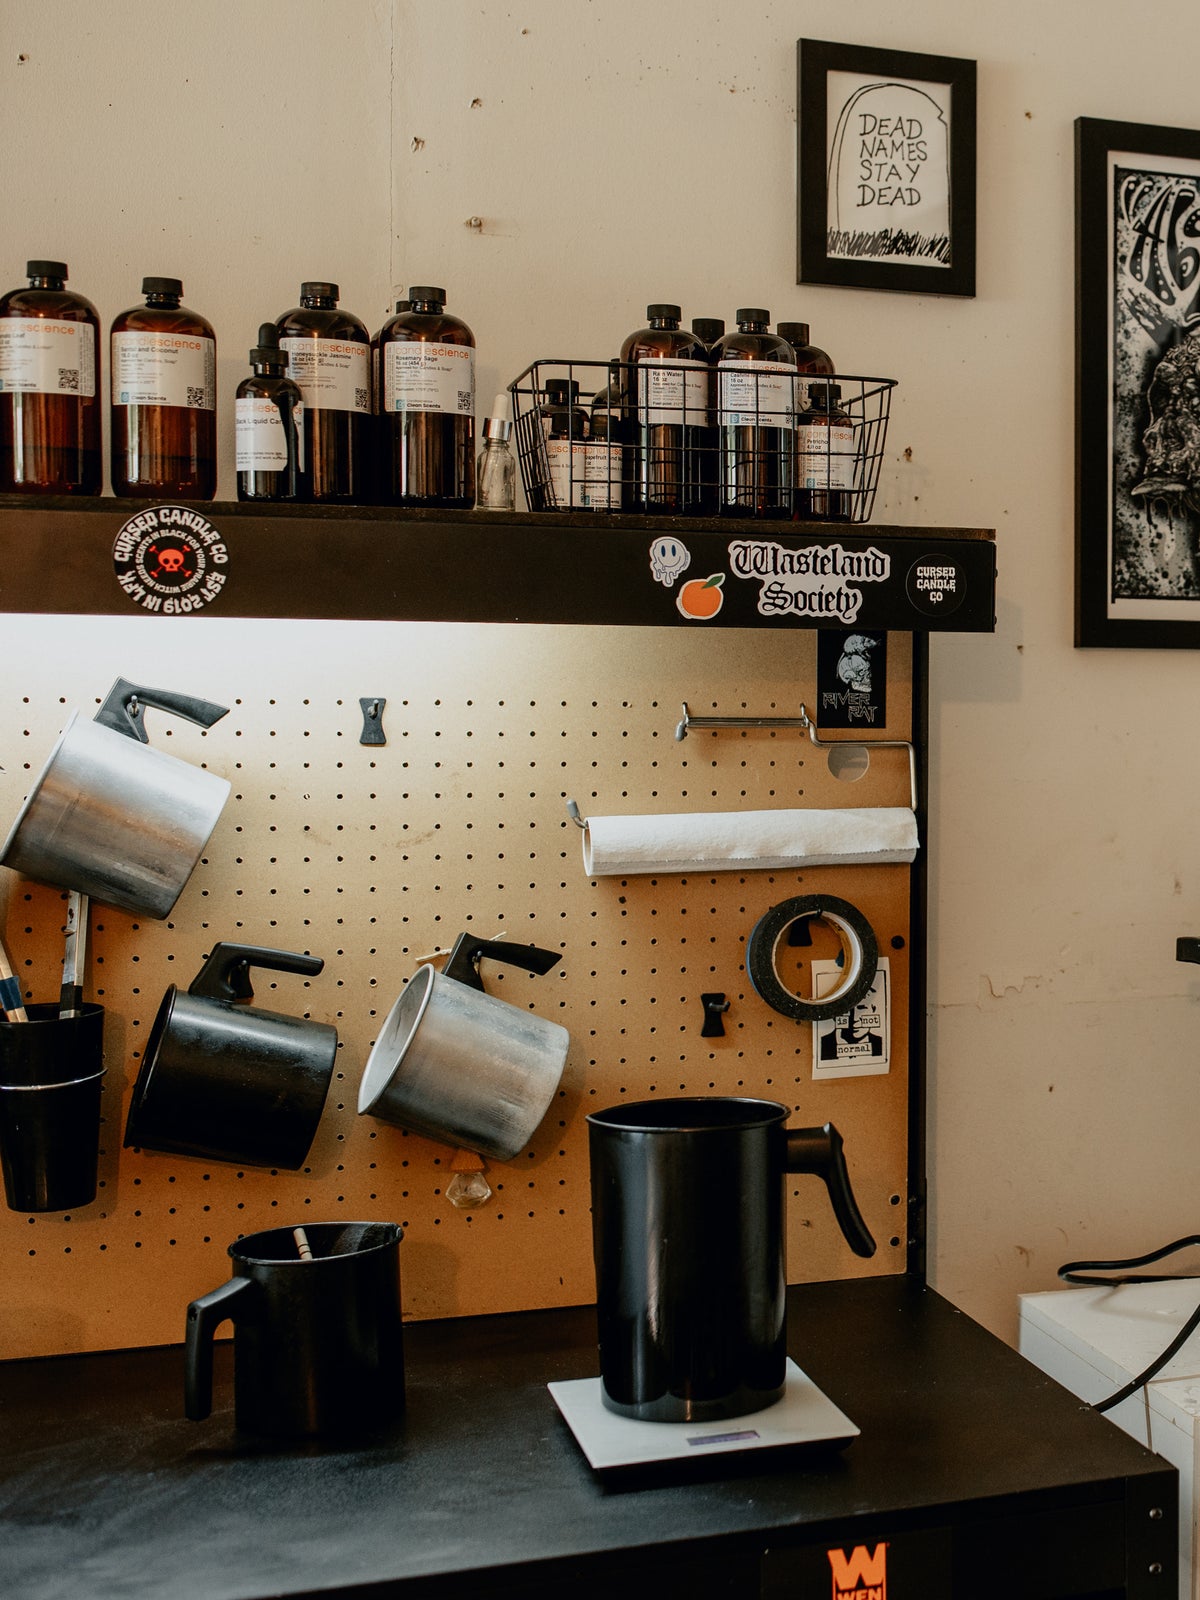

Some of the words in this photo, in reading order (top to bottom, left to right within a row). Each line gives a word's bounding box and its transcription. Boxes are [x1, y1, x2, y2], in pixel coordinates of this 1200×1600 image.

[859, 114, 922, 139] DEAD
[860, 137, 927, 161] NAMES
[860, 159, 920, 183] STAY
[857, 184, 921, 207] DEAD
[114, 511, 158, 561] CURSED
[160, 509, 221, 546] CANDLE
[209, 543, 228, 563] CO
[150, 530, 160, 540] IN
[160, 529, 187, 540] BLACK
[185, 535, 200, 549] FOR
[195, 548, 206, 568] YOUR
[733, 544, 885, 577] Wasteland
[917, 567, 955, 579] CURSED
[117, 570, 146, 601] LFK
[154, 583, 181, 593] WITCH
[200, 572, 226, 602] EST
[917, 579, 956, 592] CANDLE
[142, 595, 162, 611] IN
[163, 594, 204, 613] 2019
[762, 581, 858, 619] Society
[930, 592, 943, 604] CO
[822, 689, 870, 709] RIVER
[848, 705, 878, 723] RAT
[837, 1017, 848, 1025] is
[861, 1016, 879, 1024] not
[837, 1044, 870, 1053] normal
